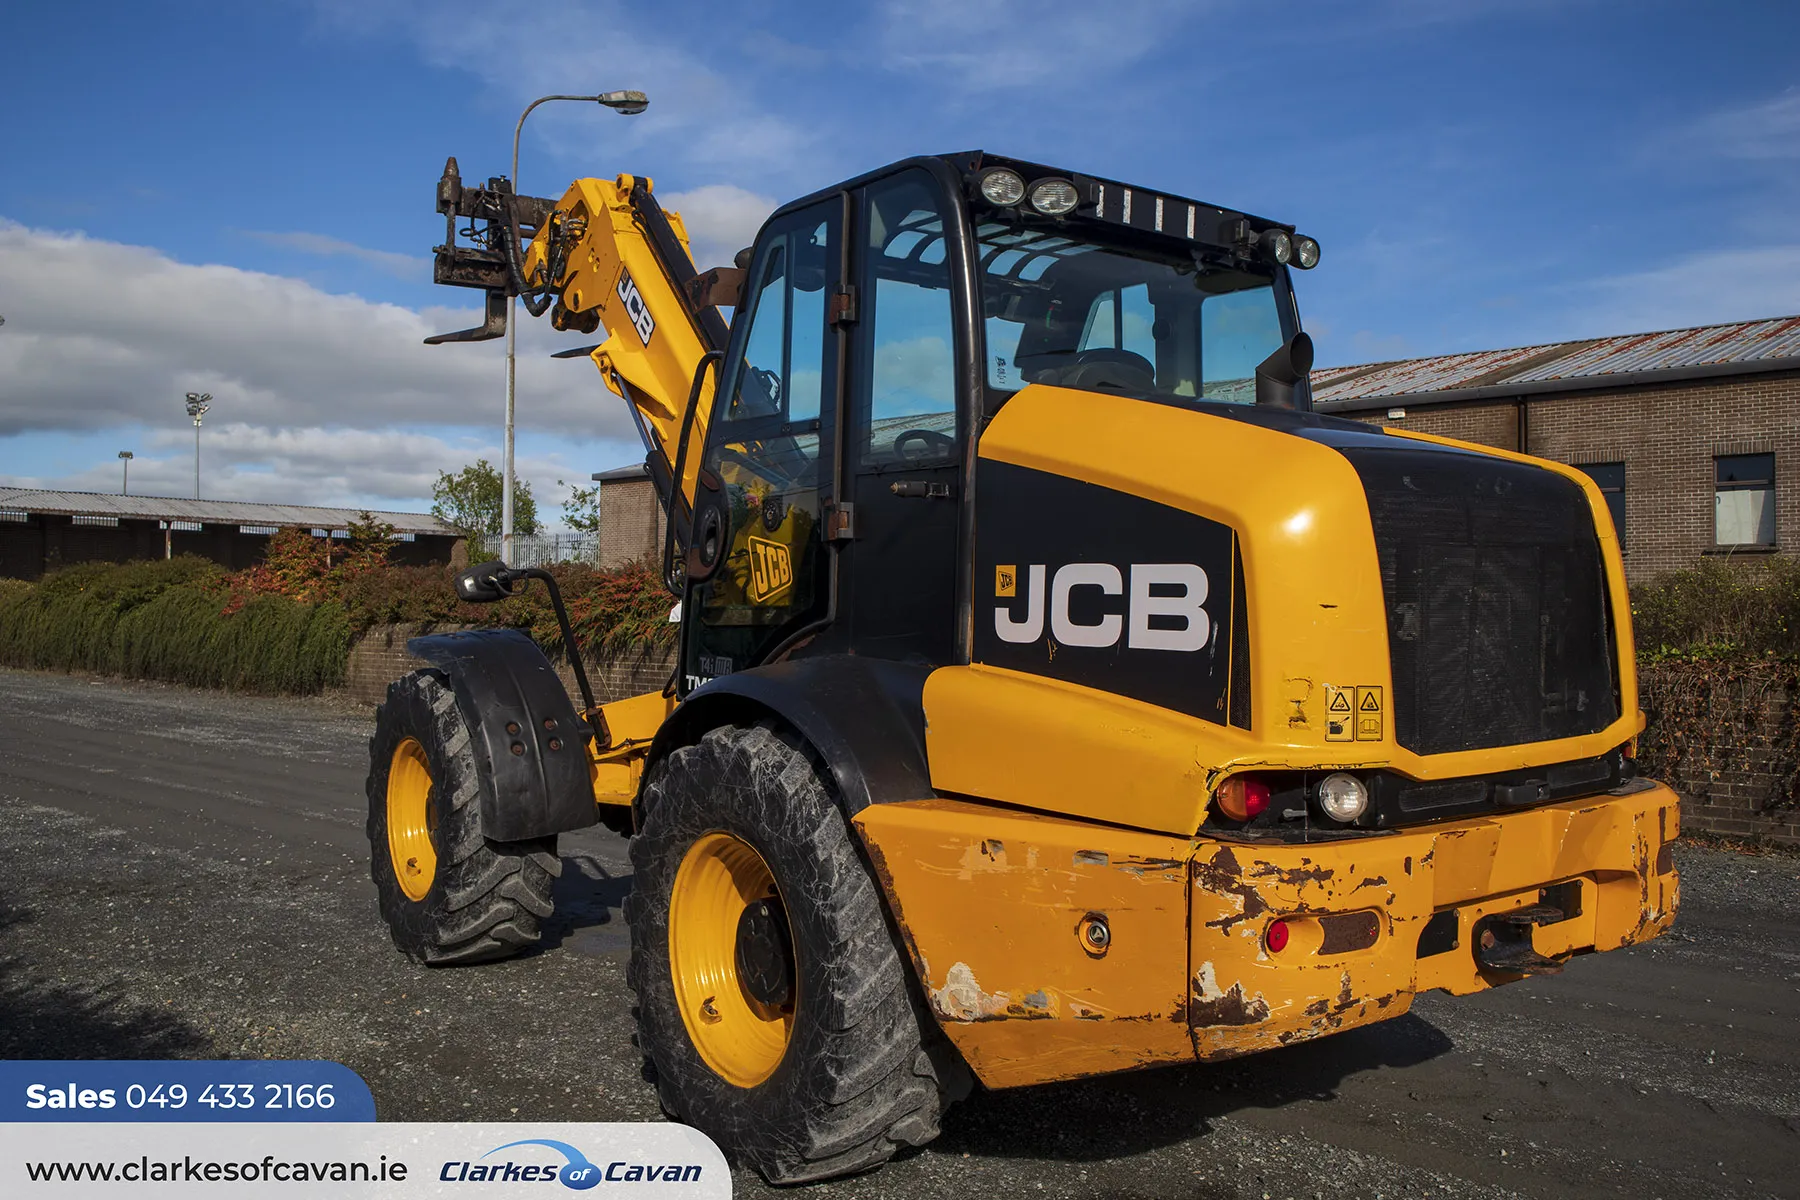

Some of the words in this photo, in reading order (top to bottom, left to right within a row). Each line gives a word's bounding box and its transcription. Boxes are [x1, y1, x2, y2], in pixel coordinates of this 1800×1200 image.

[617, 278, 654, 344] JCB
[756, 543, 789, 593] JCB
[1001, 574, 1013, 588] JCB
[995, 563, 1210, 652] JCB
[685, 674, 714, 691] TM
